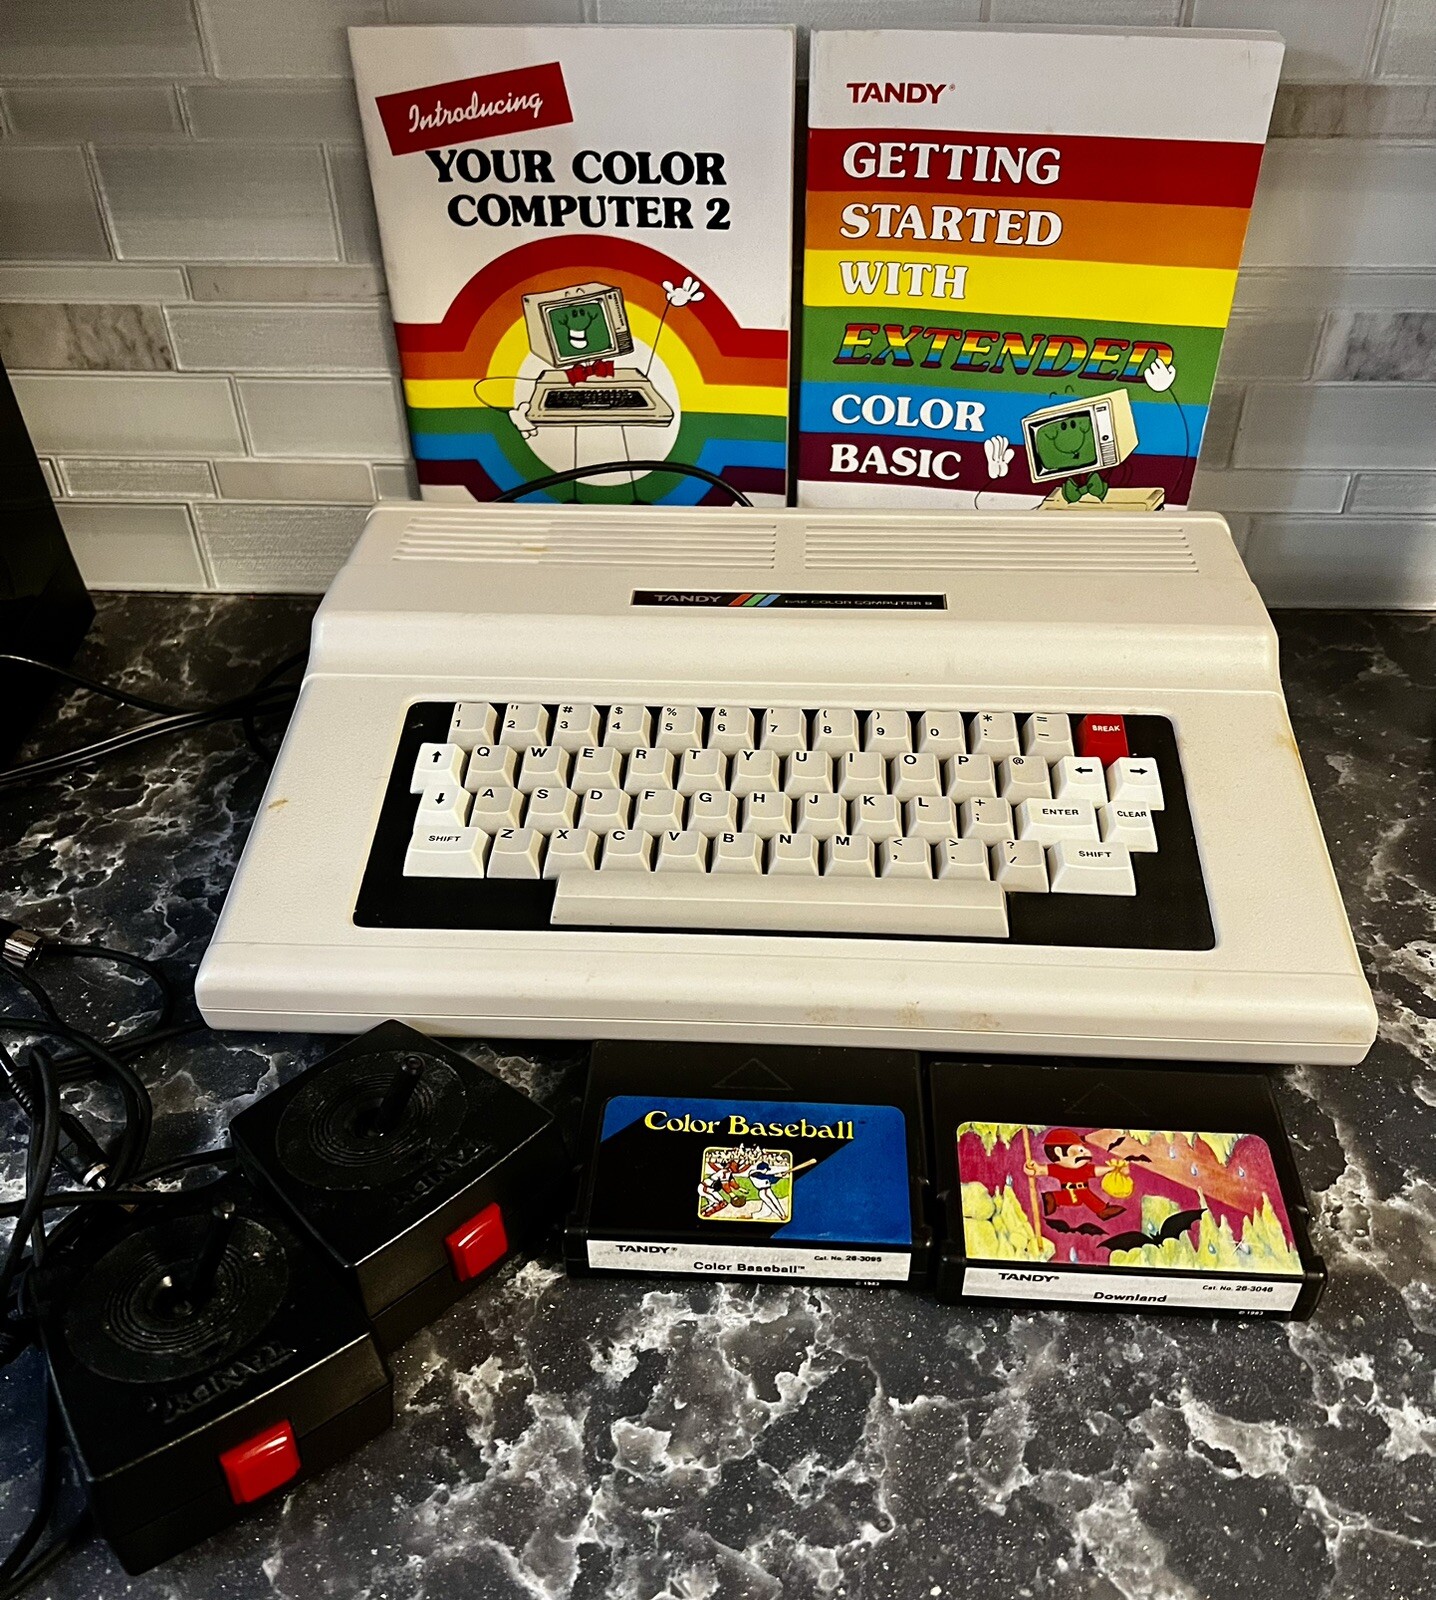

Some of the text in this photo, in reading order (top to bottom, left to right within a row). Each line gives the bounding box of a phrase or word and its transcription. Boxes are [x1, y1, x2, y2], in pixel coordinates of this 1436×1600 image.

[408, 91, 544, 133] Introducing
[425, 149, 727, 186] YOUR COLOR
[843, 141, 1061, 185] GETTING
[447, 193, 731, 230] COMPUTER 2
[839, 202, 1064, 247] STARTED
[838, 261, 969, 300] WITH
[833, 322, 1174, 384] EXTENDED
[831, 394, 987, 433] COLOR
[829, 444, 962, 481] BASIC
[654, 594, 722, 603] TANDY
[562, 705, 574, 714] #
[614, 706, 624, 715] $
[666, 707, 678, 717] %
[718, 708, 728, 717] &
[455, 719, 461, 728] 1
[506, 719, 516, 729] 2
[560, 720, 569, 729] 3
[612, 721, 621, 730] 4
[664, 722, 674, 731] 5
[717, 723, 726, 732] 6
[770, 724, 779, 733] 7
[1092, 724, 1121, 733] BREAK
[823, 725, 833, 734] 8
[876, 727, 885, 736] 9
[476, 746, 491, 758] Q
[530, 747, 548, 758] W
[582, 748, 595, 758] E
[635, 749, 648, 759] R
[689, 749, 701, 760] T
[742, 751, 755, 761] Y
[795, 752, 808, 762] U
[849, 752, 854, 763] I
[903, 754, 917, 765] O
[957, 755, 969, 765] P
[1012, 756, 1025, 765] @
[482, 788, 495, 798] A
[536, 788, 549, 799] S
[590, 789, 603, 800] D
[644, 790, 656, 800] F
[699, 792, 713, 803] G
[753, 793, 765, 803] H
[809, 794, 819, 805] J
[862, 795, 876, 806] K
[918, 797, 929, 808] L
[1042, 808, 1079, 816] ENTER
[1116, 809, 1147, 818] CLEAR
[500, 828, 515, 839] Z
[556, 829, 570, 840] X
[612, 830, 625, 841] C
[668, 831, 681, 841] V
[722, 833, 735, 843] B
[779, 834, 792, 844] N
[835, 835, 850, 846] M
[1006, 840, 1015, 849] ?
[1078, 850, 1112, 858] SHIFT
[644, 1109, 855, 1140] Color Baseball
[693, 1261, 732, 1272] Color
[1093, 1291, 1167, 1304] Downland
